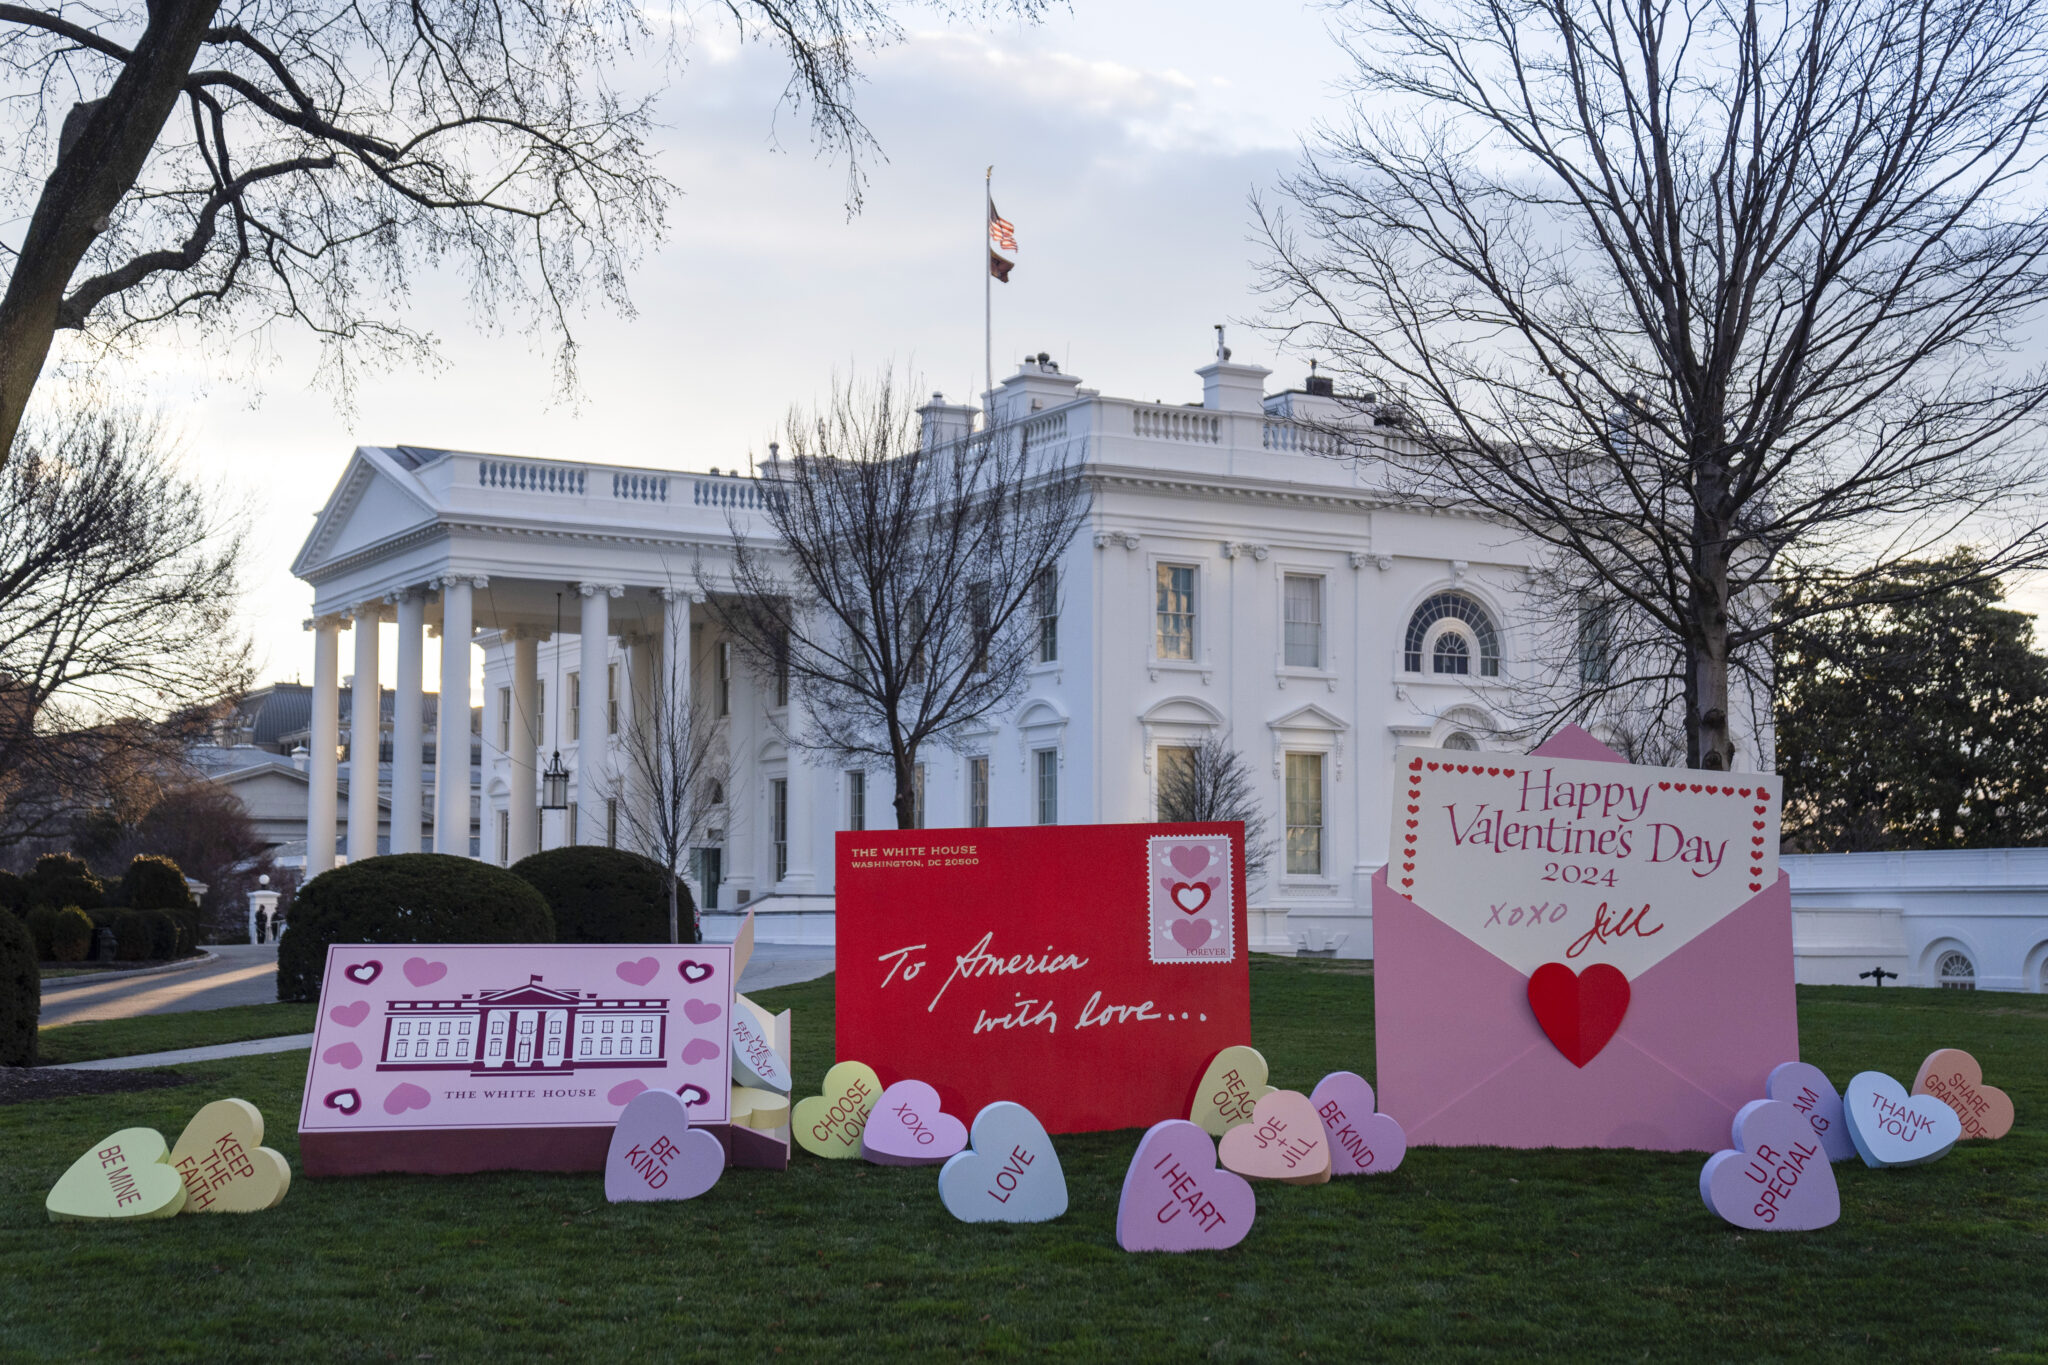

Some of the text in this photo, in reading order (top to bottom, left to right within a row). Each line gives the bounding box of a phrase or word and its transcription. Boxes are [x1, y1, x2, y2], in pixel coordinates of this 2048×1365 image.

[1516, 767, 1653, 822] Happy
[851, 846, 977, 857] THE WHITE HOUSE
[1442, 803, 1729, 878] Valentine's Day
[851, 860, 924, 868] WASHINGTON,
[945, 858, 979, 866] 20500
[1540, 862, 1619, 887] 2024
[1565, 901, 1664, 958] Jill
[878, 931, 1089, 1012] To America
[1186, 948, 1226, 956] FOREVER
[973, 992, 1057, 1034] with
[733, 1028, 745, 1042] IN
[737, 1021, 776, 1078] BELIEVE
[755, 1035, 772, 1056] WE
[746, 1046, 767, 1076] YOU
[444, 1089, 597, 1099] THE WHITE HOUSE
[812, 1078, 871, 1141] CHOOSE
[1213, 1091, 1242, 1123] OUT
[1872, 1092, 1936, 1134] THANK
[1949, 1073, 1990, 1117] SHARE
[892, 1102, 935, 1145] XOXO
[1254, 1116, 1287, 1149] JOE
[1318, 1100, 1375, 1168] BE KIND
[1878, 1113, 1917, 1142] YOU
[200, 1149, 232, 1190] THE
[215, 1131, 255, 1178] KEEP
[624, 1144, 669, 1190] KIND
[649, 1135, 681, 1167] BE
[1282, 1137, 1318, 1168] JILL
[1744, 1144, 1780, 1184] U R
[98, 1145, 142, 1208] BE MINE
[175, 1156, 216, 1209] FAITH
[988, 1145, 1035, 1203] LOVE
[1153, 1152, 1226, 1233] I HEART
[1753, 1141, 1818, 1223] SPECIAL
[1157, 1200, 1181, 1224] U
